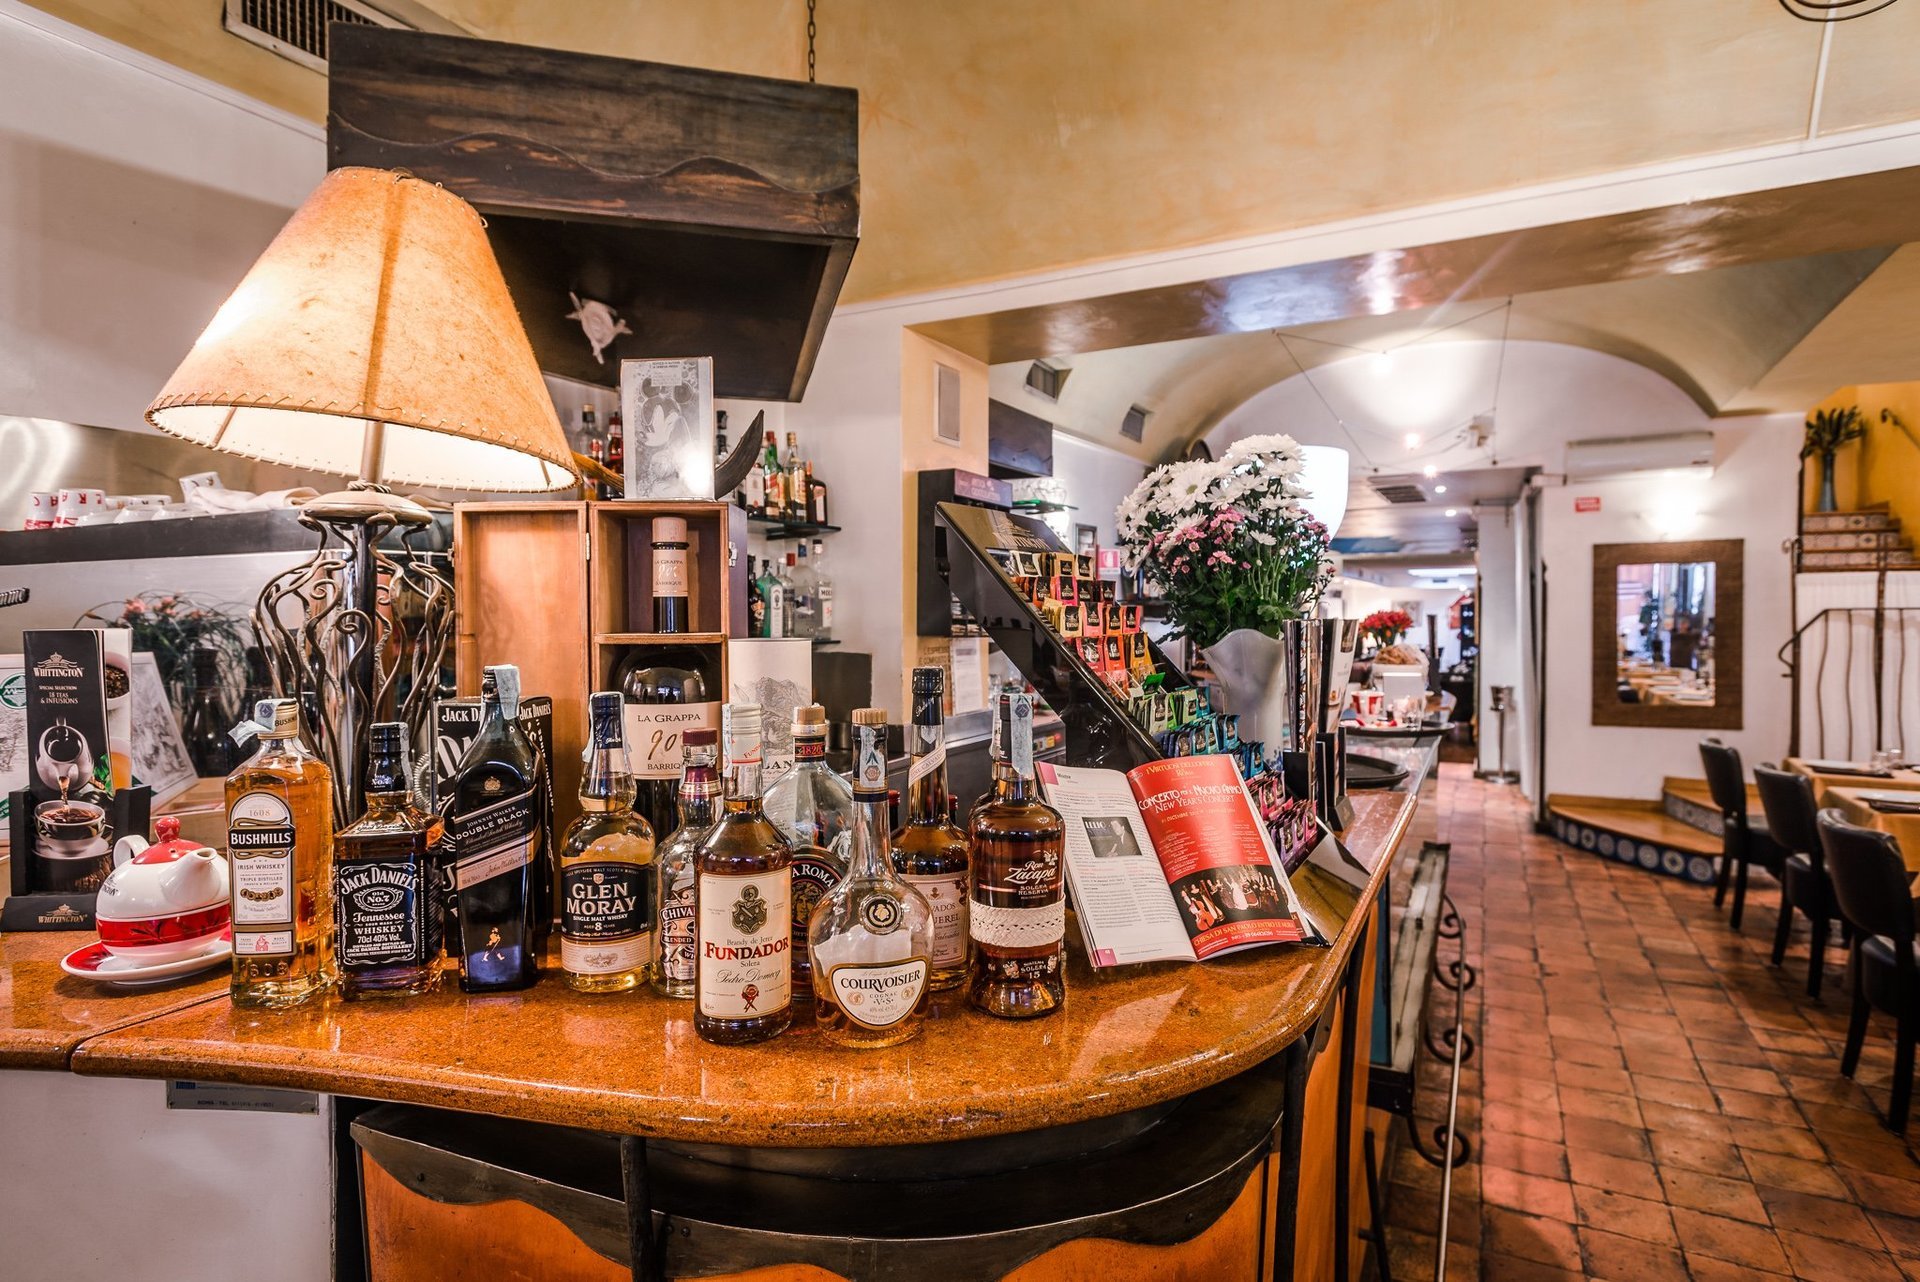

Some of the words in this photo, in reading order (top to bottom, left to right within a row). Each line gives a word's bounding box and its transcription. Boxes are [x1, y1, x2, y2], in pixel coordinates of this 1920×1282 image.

[33, 667, 83, 678] WHITTINGTON
[442, 707, 469, 722] JACK
[519, 706, 533, 721] JACK
[637, 714, 651, 722] LA
[654, 713, 701, 723] GRAPPA
[647, 729, 683, 761] 90
[1138, 789, 1180, 810] CONCERTO
[1192, 784, 1222, 796] NUOVO
[1222, 783, 1242, 794] ANNO
[1155, 799, 1176, 814] NEW
[1202, 794, 1235, 804] CONCERT
[249, 809, 271, 817] 1608
[466, 815, 493, 829] JOHNNIE
[492, 806, 516, 818] WALKER
[456, 821, 495, 840] DOUBLE
[497, 808, 530, 825] BLACK
[231, 832, 292, 845] BUSHMILLS
[1022, 860, 1044, 871] Ron
[340, 871, 371, 895] JACK
[370, 867, 420, 891] DANIEL'S
[801, 864, 836, 888] ROMA
[1003, 866, 1057, 885] Zacapa
[572, 882, 628, 899] GLEN
[366, 895, 390, 904] No.7
[566, 896, 637, 915] MORAY
[38, 915, 83, 924] WHITTINGTON
[353, 912, 405, 923] Tennessee
[607, 913, 628, 921] WHISKY
[661, 906, 695, 922] CHIVA
[353, 924, 404, 935] WHISKEY
[594, 922, 603, 931] 8
[1214, 929, 1223, 937] DI
[1223, 925, 1237, 934] SAN
[357, 936, 372, 944] 70cl
[373, 934, 388, 943] 40%
[726, 938, 748, 946] Brandy
[760, 935, 773, 944] Jerez
[705, 937, 789, 960] FUNDADOR
[740, 960, 761, 968] Solera
[715, 969, 745, 984] Pedro
[840, 969, 921, 992] COURVOISIER
